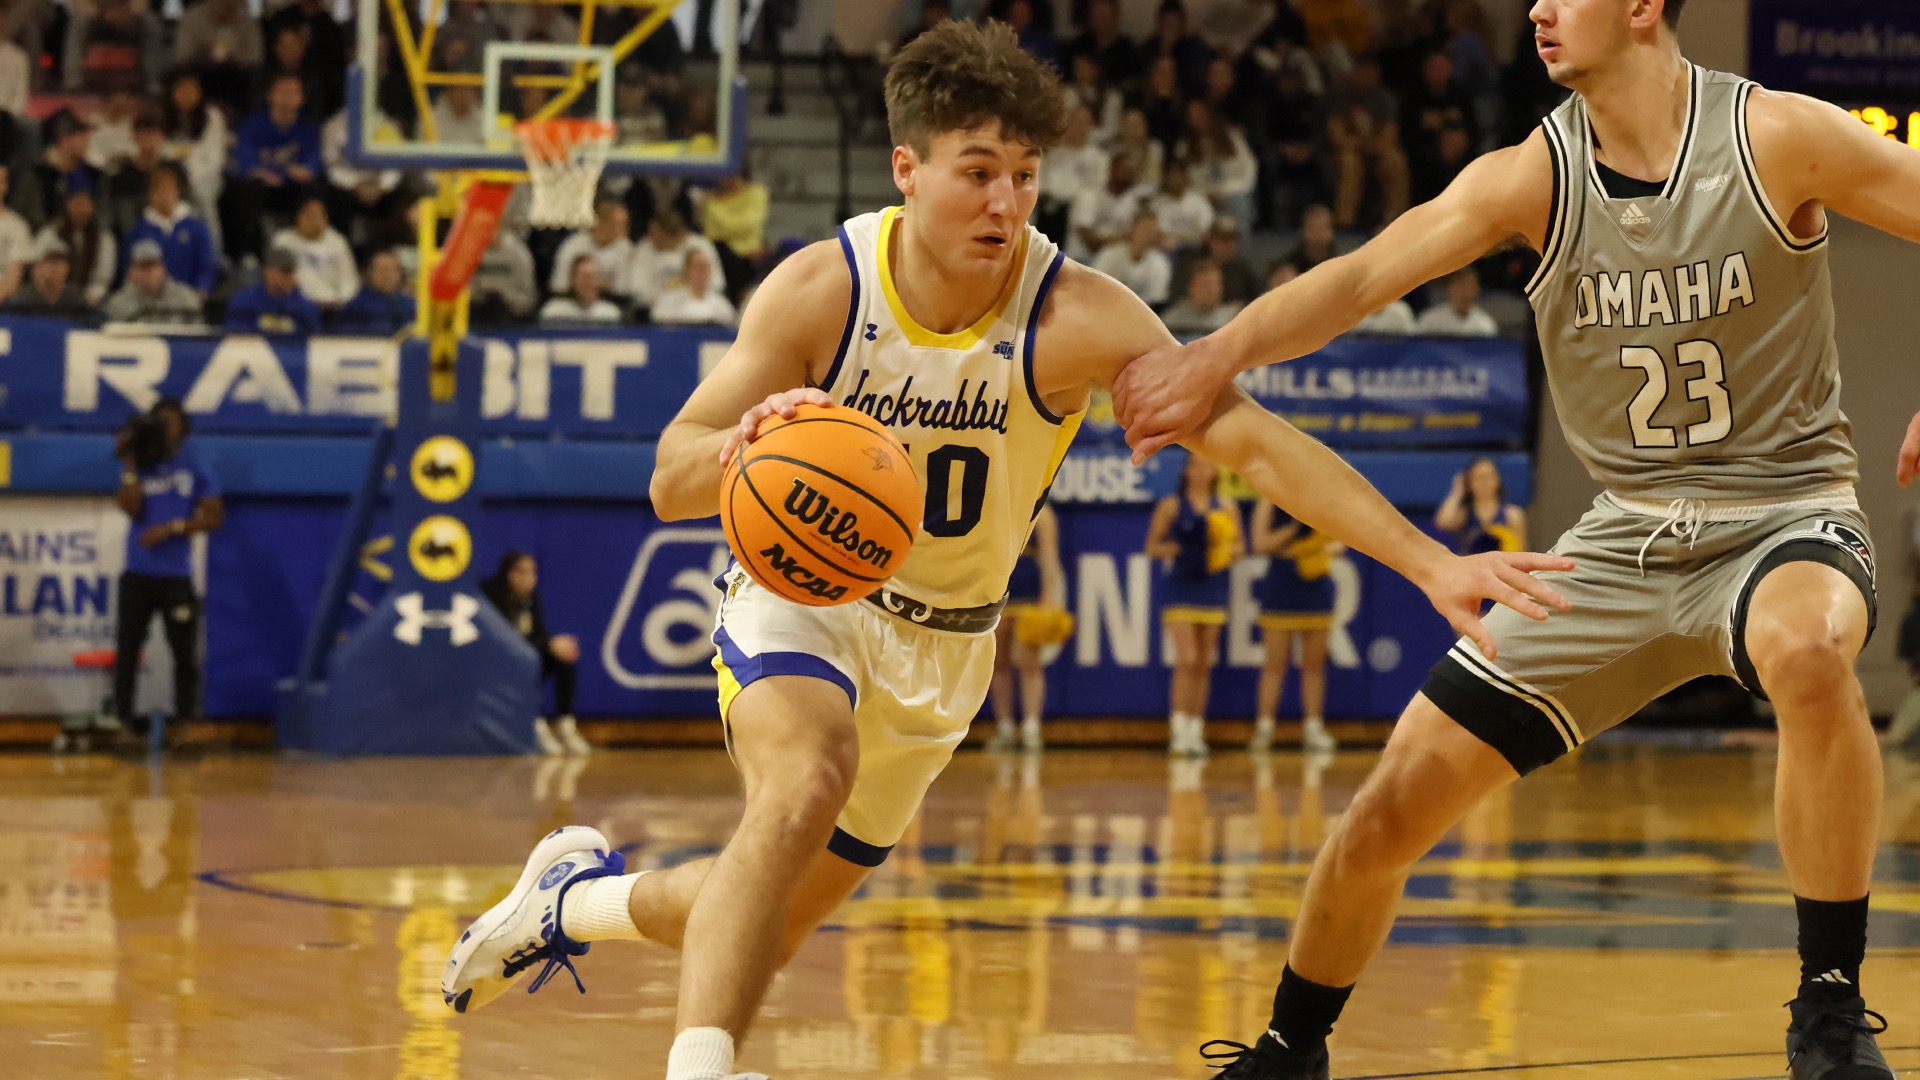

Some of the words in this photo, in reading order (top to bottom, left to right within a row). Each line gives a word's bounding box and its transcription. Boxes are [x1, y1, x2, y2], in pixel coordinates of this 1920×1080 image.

[1620, 216, 1651, 225] adidas
[1575, 251, 1756, 329] OMAHA
[1620, 338, 1733, 448] 23
[784, 477, 893, 569] Wilson
[902, 443, 989, 537] 0
[760, 543, 849, 600] NCAA
